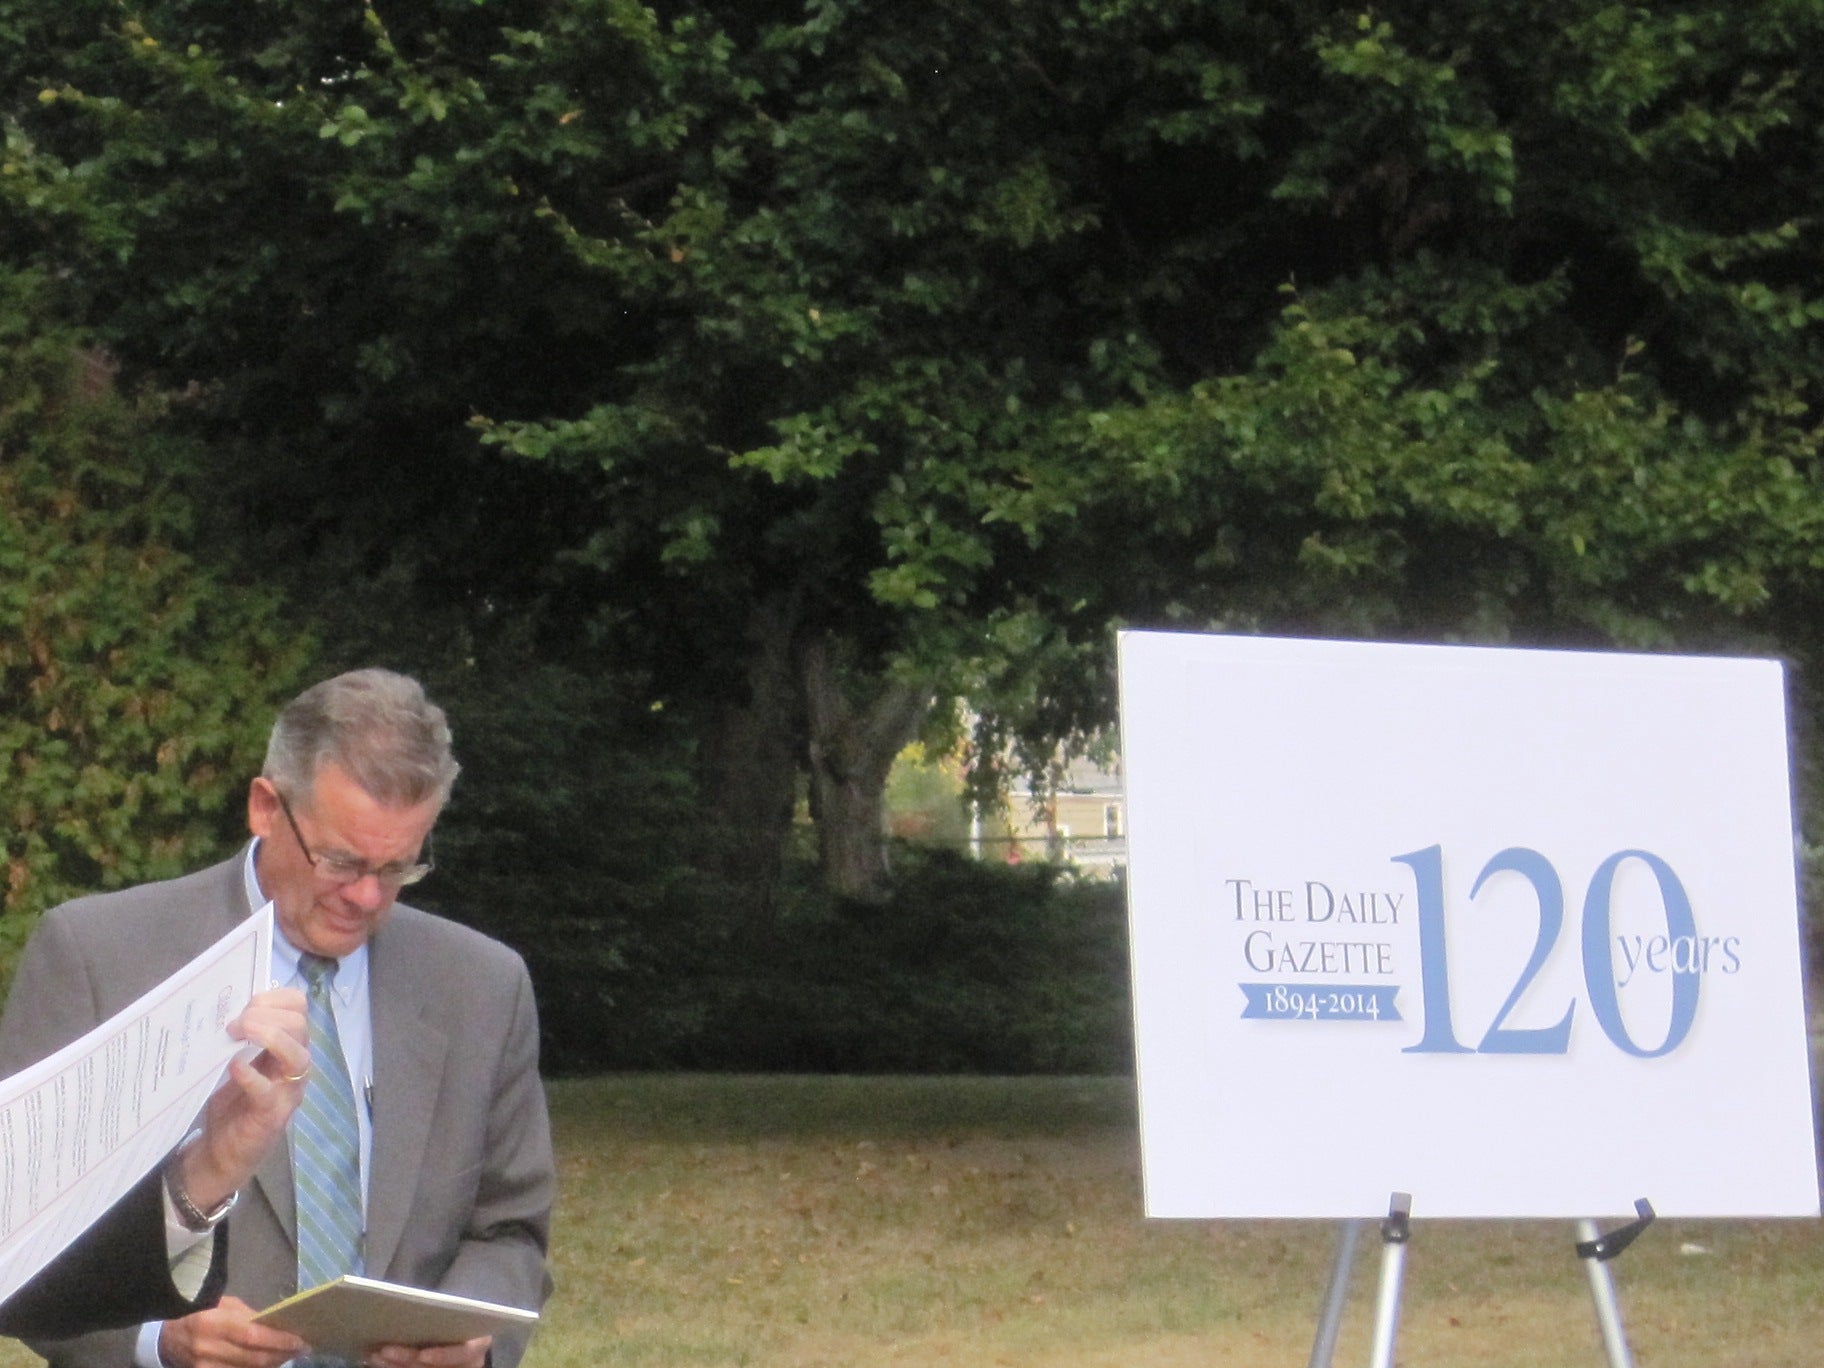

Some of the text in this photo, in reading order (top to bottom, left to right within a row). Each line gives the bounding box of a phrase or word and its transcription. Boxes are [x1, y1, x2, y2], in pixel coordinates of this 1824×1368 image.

[1243, 929, 1394, 974] GAZETTE
[1390, 843, 1701, 1059] 120
[1617, 933, 1742, 988] years
[1266, 985, 1380, 1020] 1894-2014
